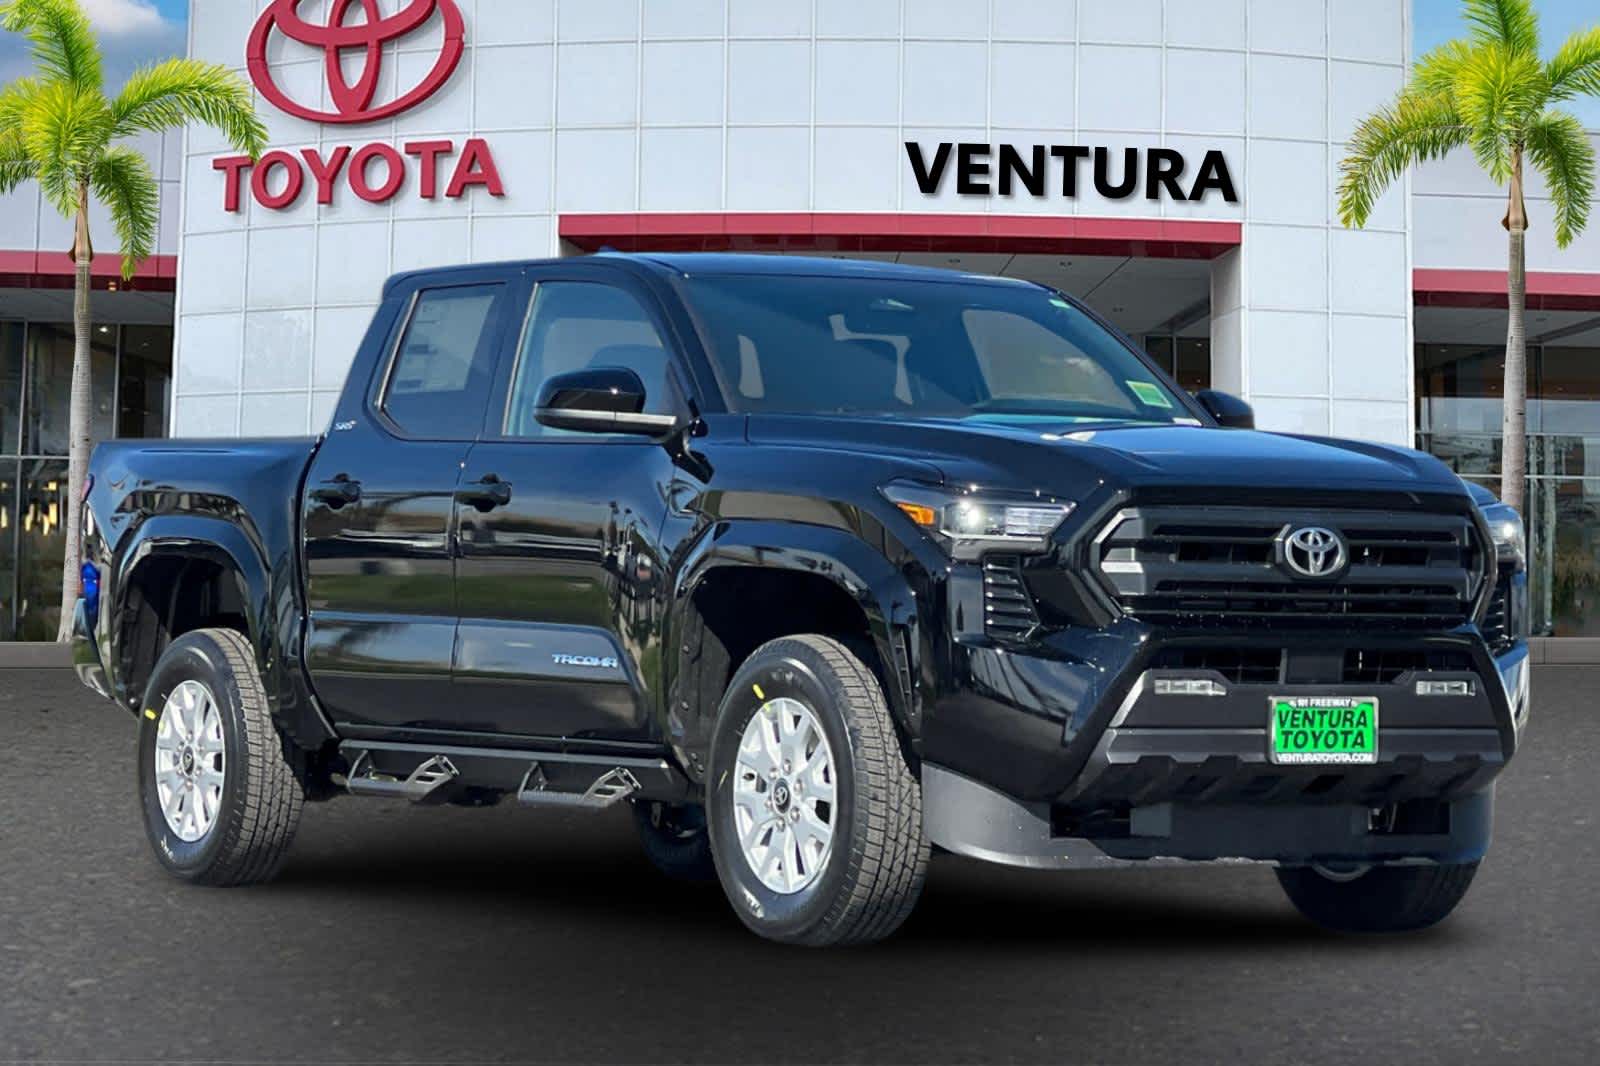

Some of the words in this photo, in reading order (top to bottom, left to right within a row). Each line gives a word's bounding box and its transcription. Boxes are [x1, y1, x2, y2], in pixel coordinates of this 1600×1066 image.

[213, 138, 505, 212] TOYOTA
[904, 142, 1239, 203] VENTURA
[551, 653, 618, 668] TACOMA
[1277, 709, 1368, 729] VENTURA
[1280, 729, 1366, 749] TOYOTA
[1277, 753, 1374, 763] VENTURATOYOTA.COM
